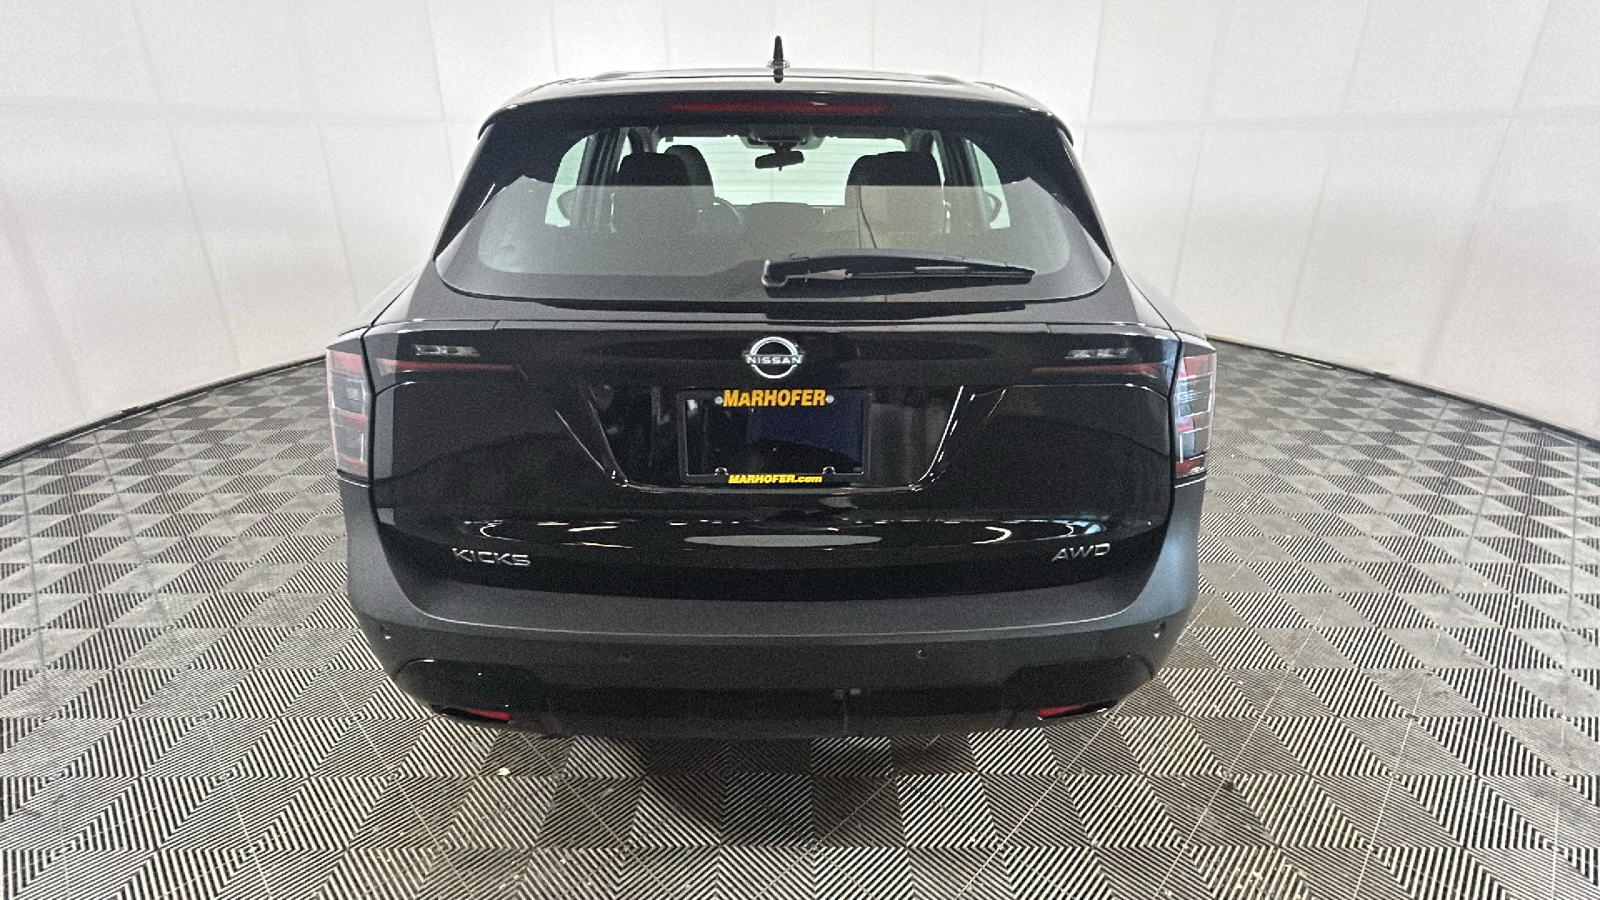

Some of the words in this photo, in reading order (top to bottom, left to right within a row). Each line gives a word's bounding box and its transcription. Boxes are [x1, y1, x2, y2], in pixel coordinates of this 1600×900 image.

[746, 355, 802, 364] NISSAN
[722, 389, 826, 408] MARHOFER
[728, 474, 823, 484] MARHOFER.com
[452, 547, 531, 566] KICKS
[1051, 542, 1111, 562] AWD
